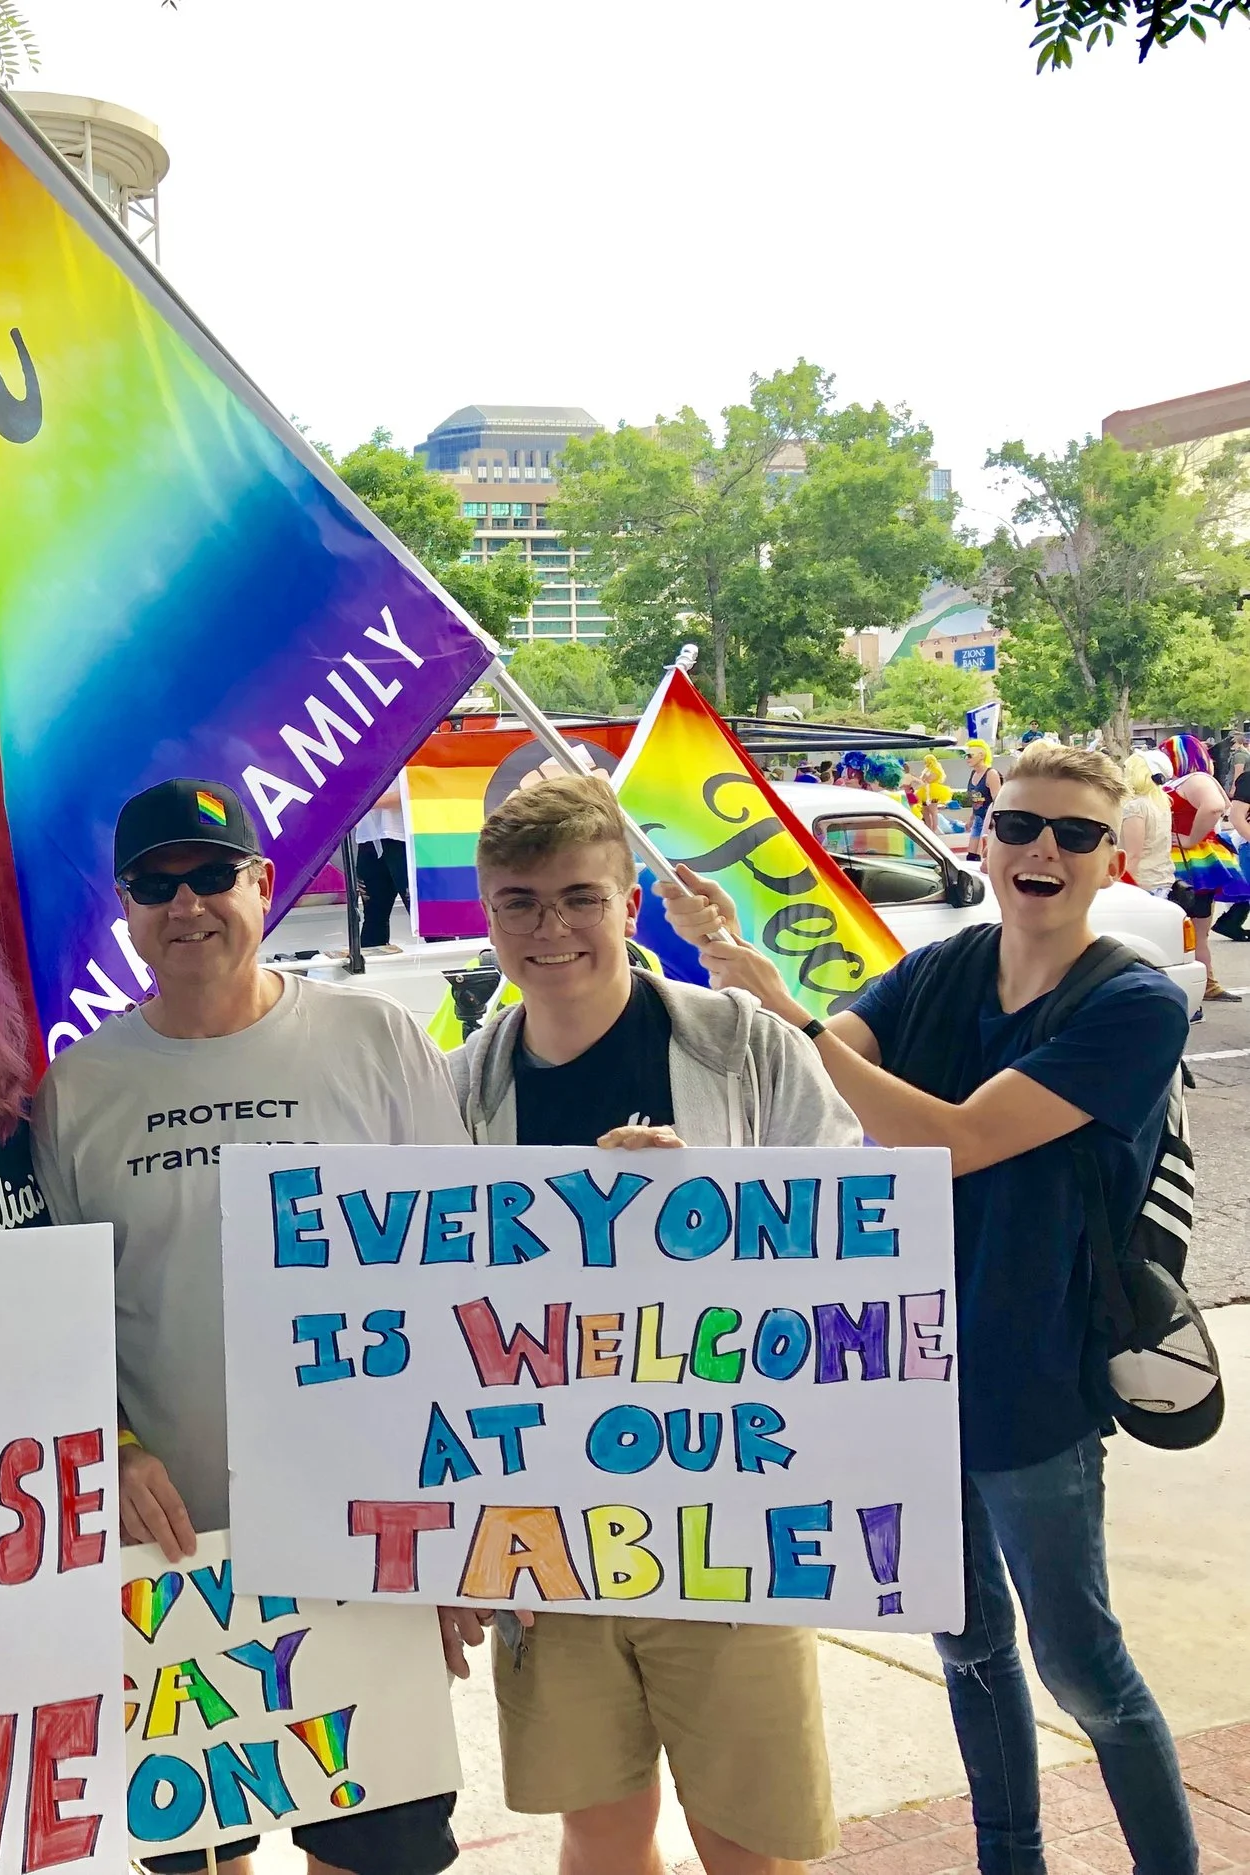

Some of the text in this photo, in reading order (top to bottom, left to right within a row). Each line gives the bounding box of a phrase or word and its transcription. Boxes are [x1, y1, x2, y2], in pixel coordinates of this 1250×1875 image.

[962, 648, 986, 660] ZIONS
[962, 658, 986, 668] BANK
[241, 605, 425, 841] AMILY
[147, 1099, 299, 1133] PROTECT
[269, 1166, 899, 1268] EVERYONE
[292, 1289, 953, 1388] IS WELCOME
[419, 1401, 796, 1488] AT OUR
[348, 1499, 904, 1616] TABLE!
[127, 1705, 367, 1842] ON!
